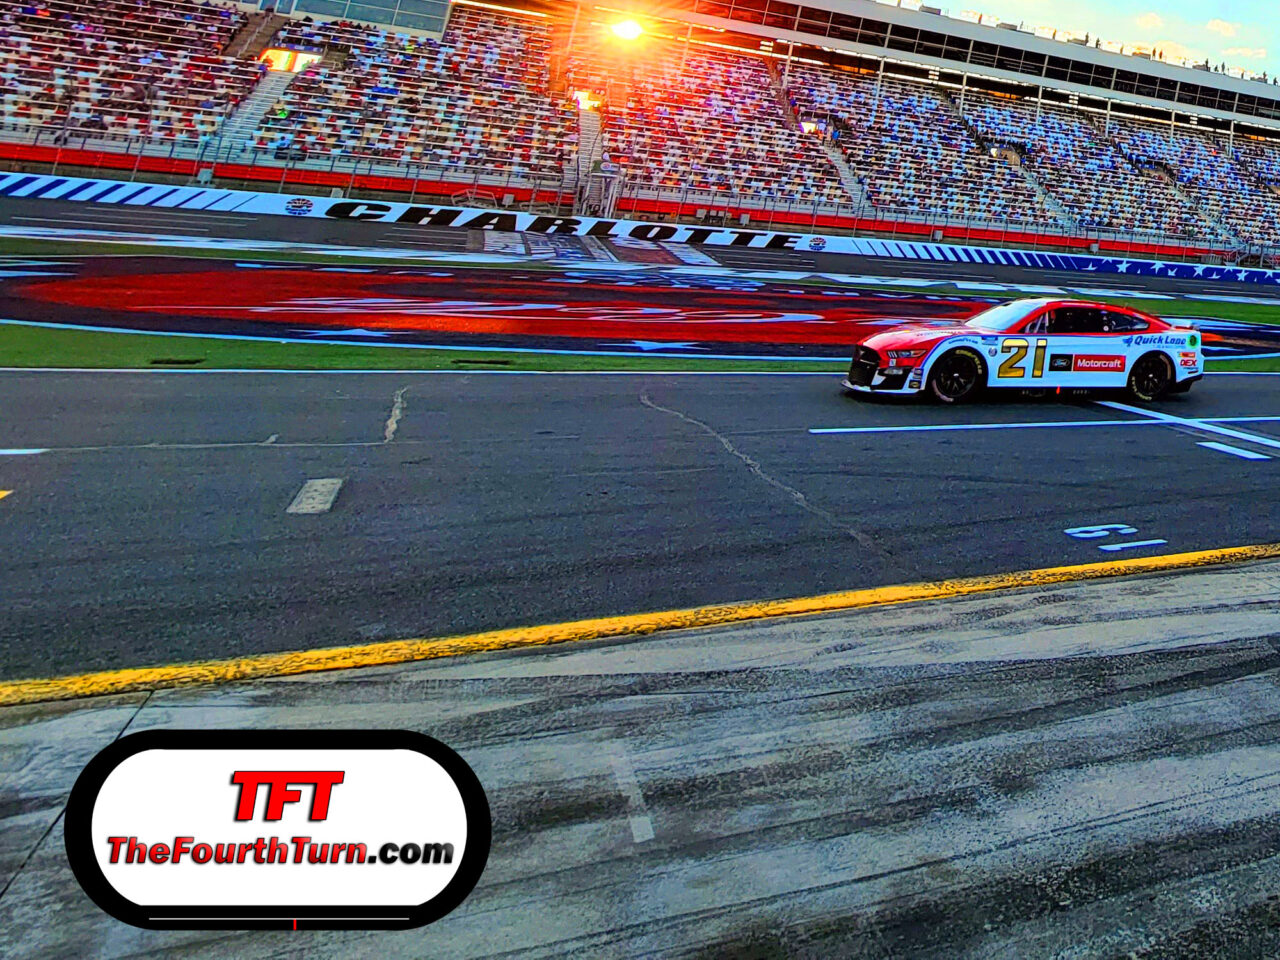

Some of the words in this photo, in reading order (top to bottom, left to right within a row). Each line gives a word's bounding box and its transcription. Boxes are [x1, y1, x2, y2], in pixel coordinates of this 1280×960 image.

[325, 201, 804, 251] CHARLOTTE
[1134, 335, 1163, 345] Quick
[997, 337, 1047, 378] 21
[1077, 358, 1122, 369] Motorcraft
